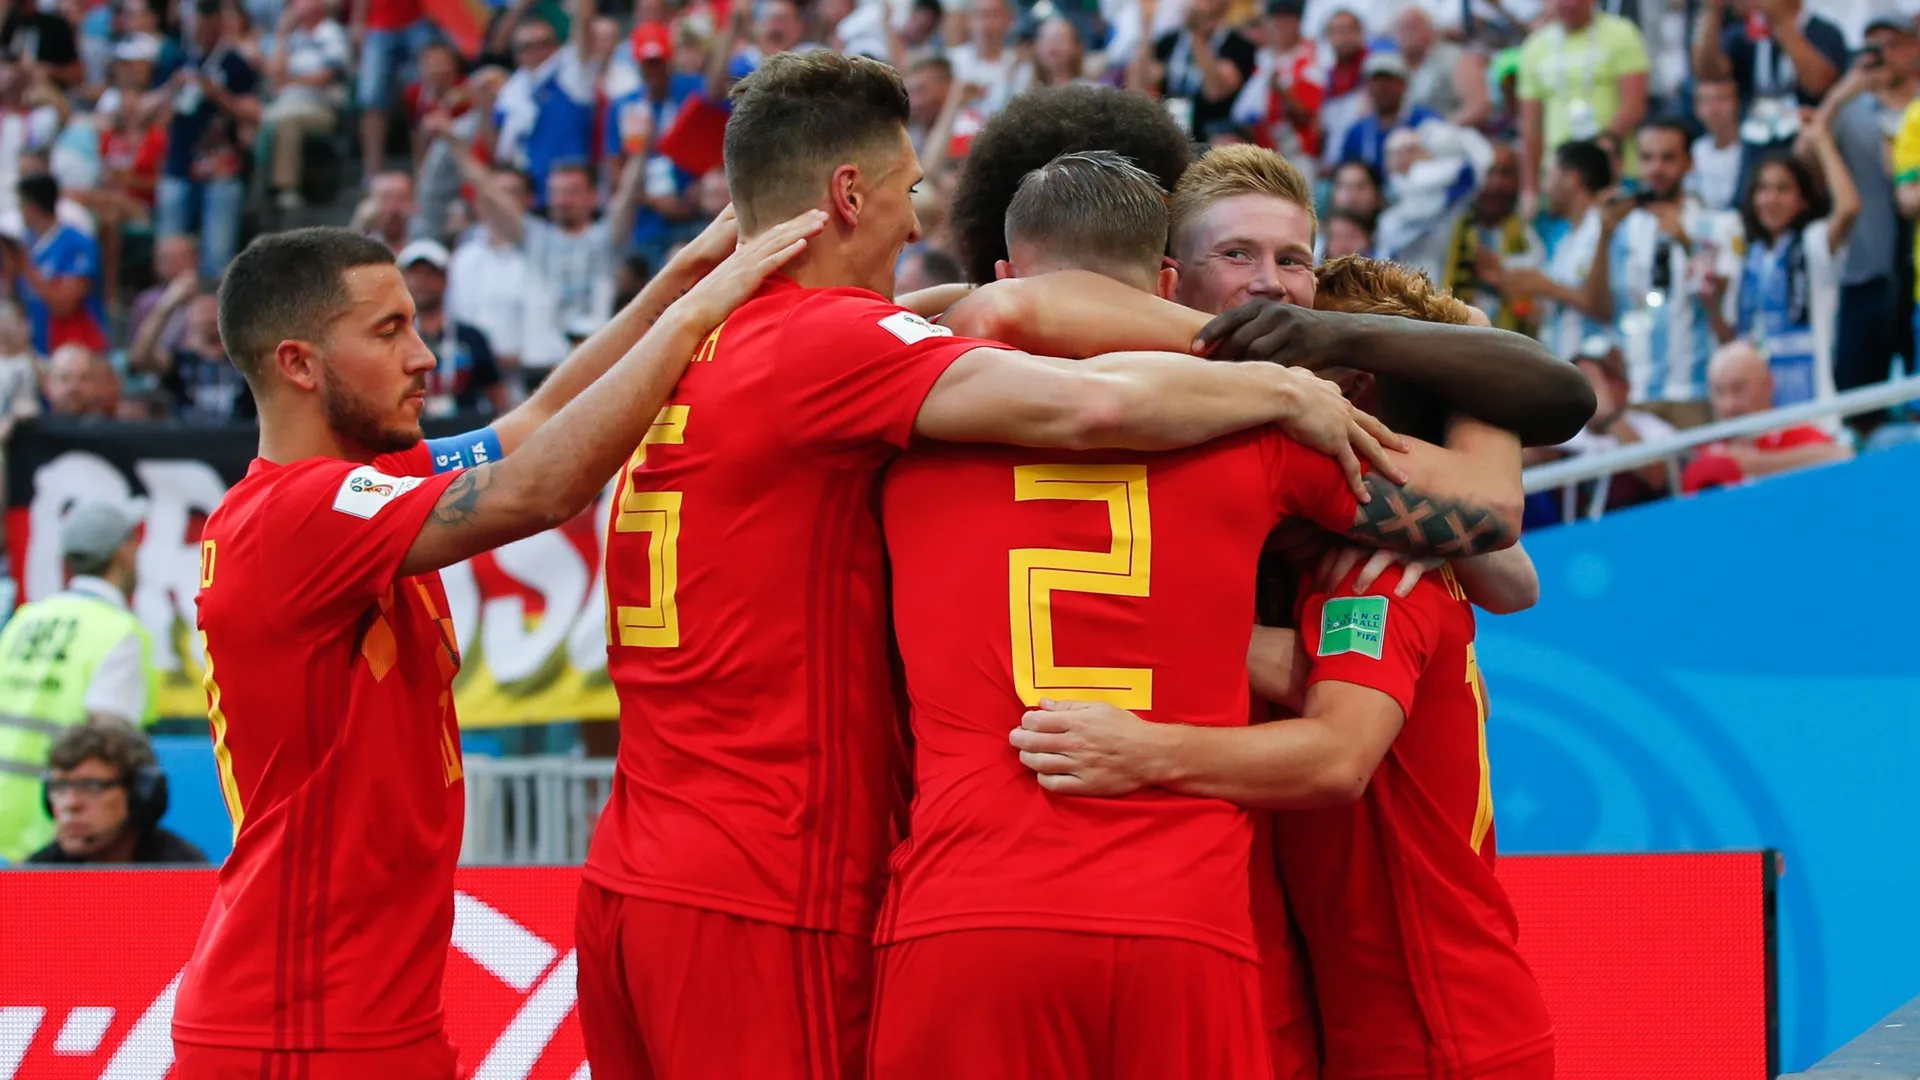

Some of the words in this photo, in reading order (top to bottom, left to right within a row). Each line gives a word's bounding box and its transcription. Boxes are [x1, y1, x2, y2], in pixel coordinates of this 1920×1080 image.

[200, 539, 217, 589] D
[1008, 464, 1152, 710] 2
[1327, 612, 1380, 622] LIVING
[1327, 617, 1379, 629] FOOTBALL
[1356, 631, 1377, 642] FIFA
